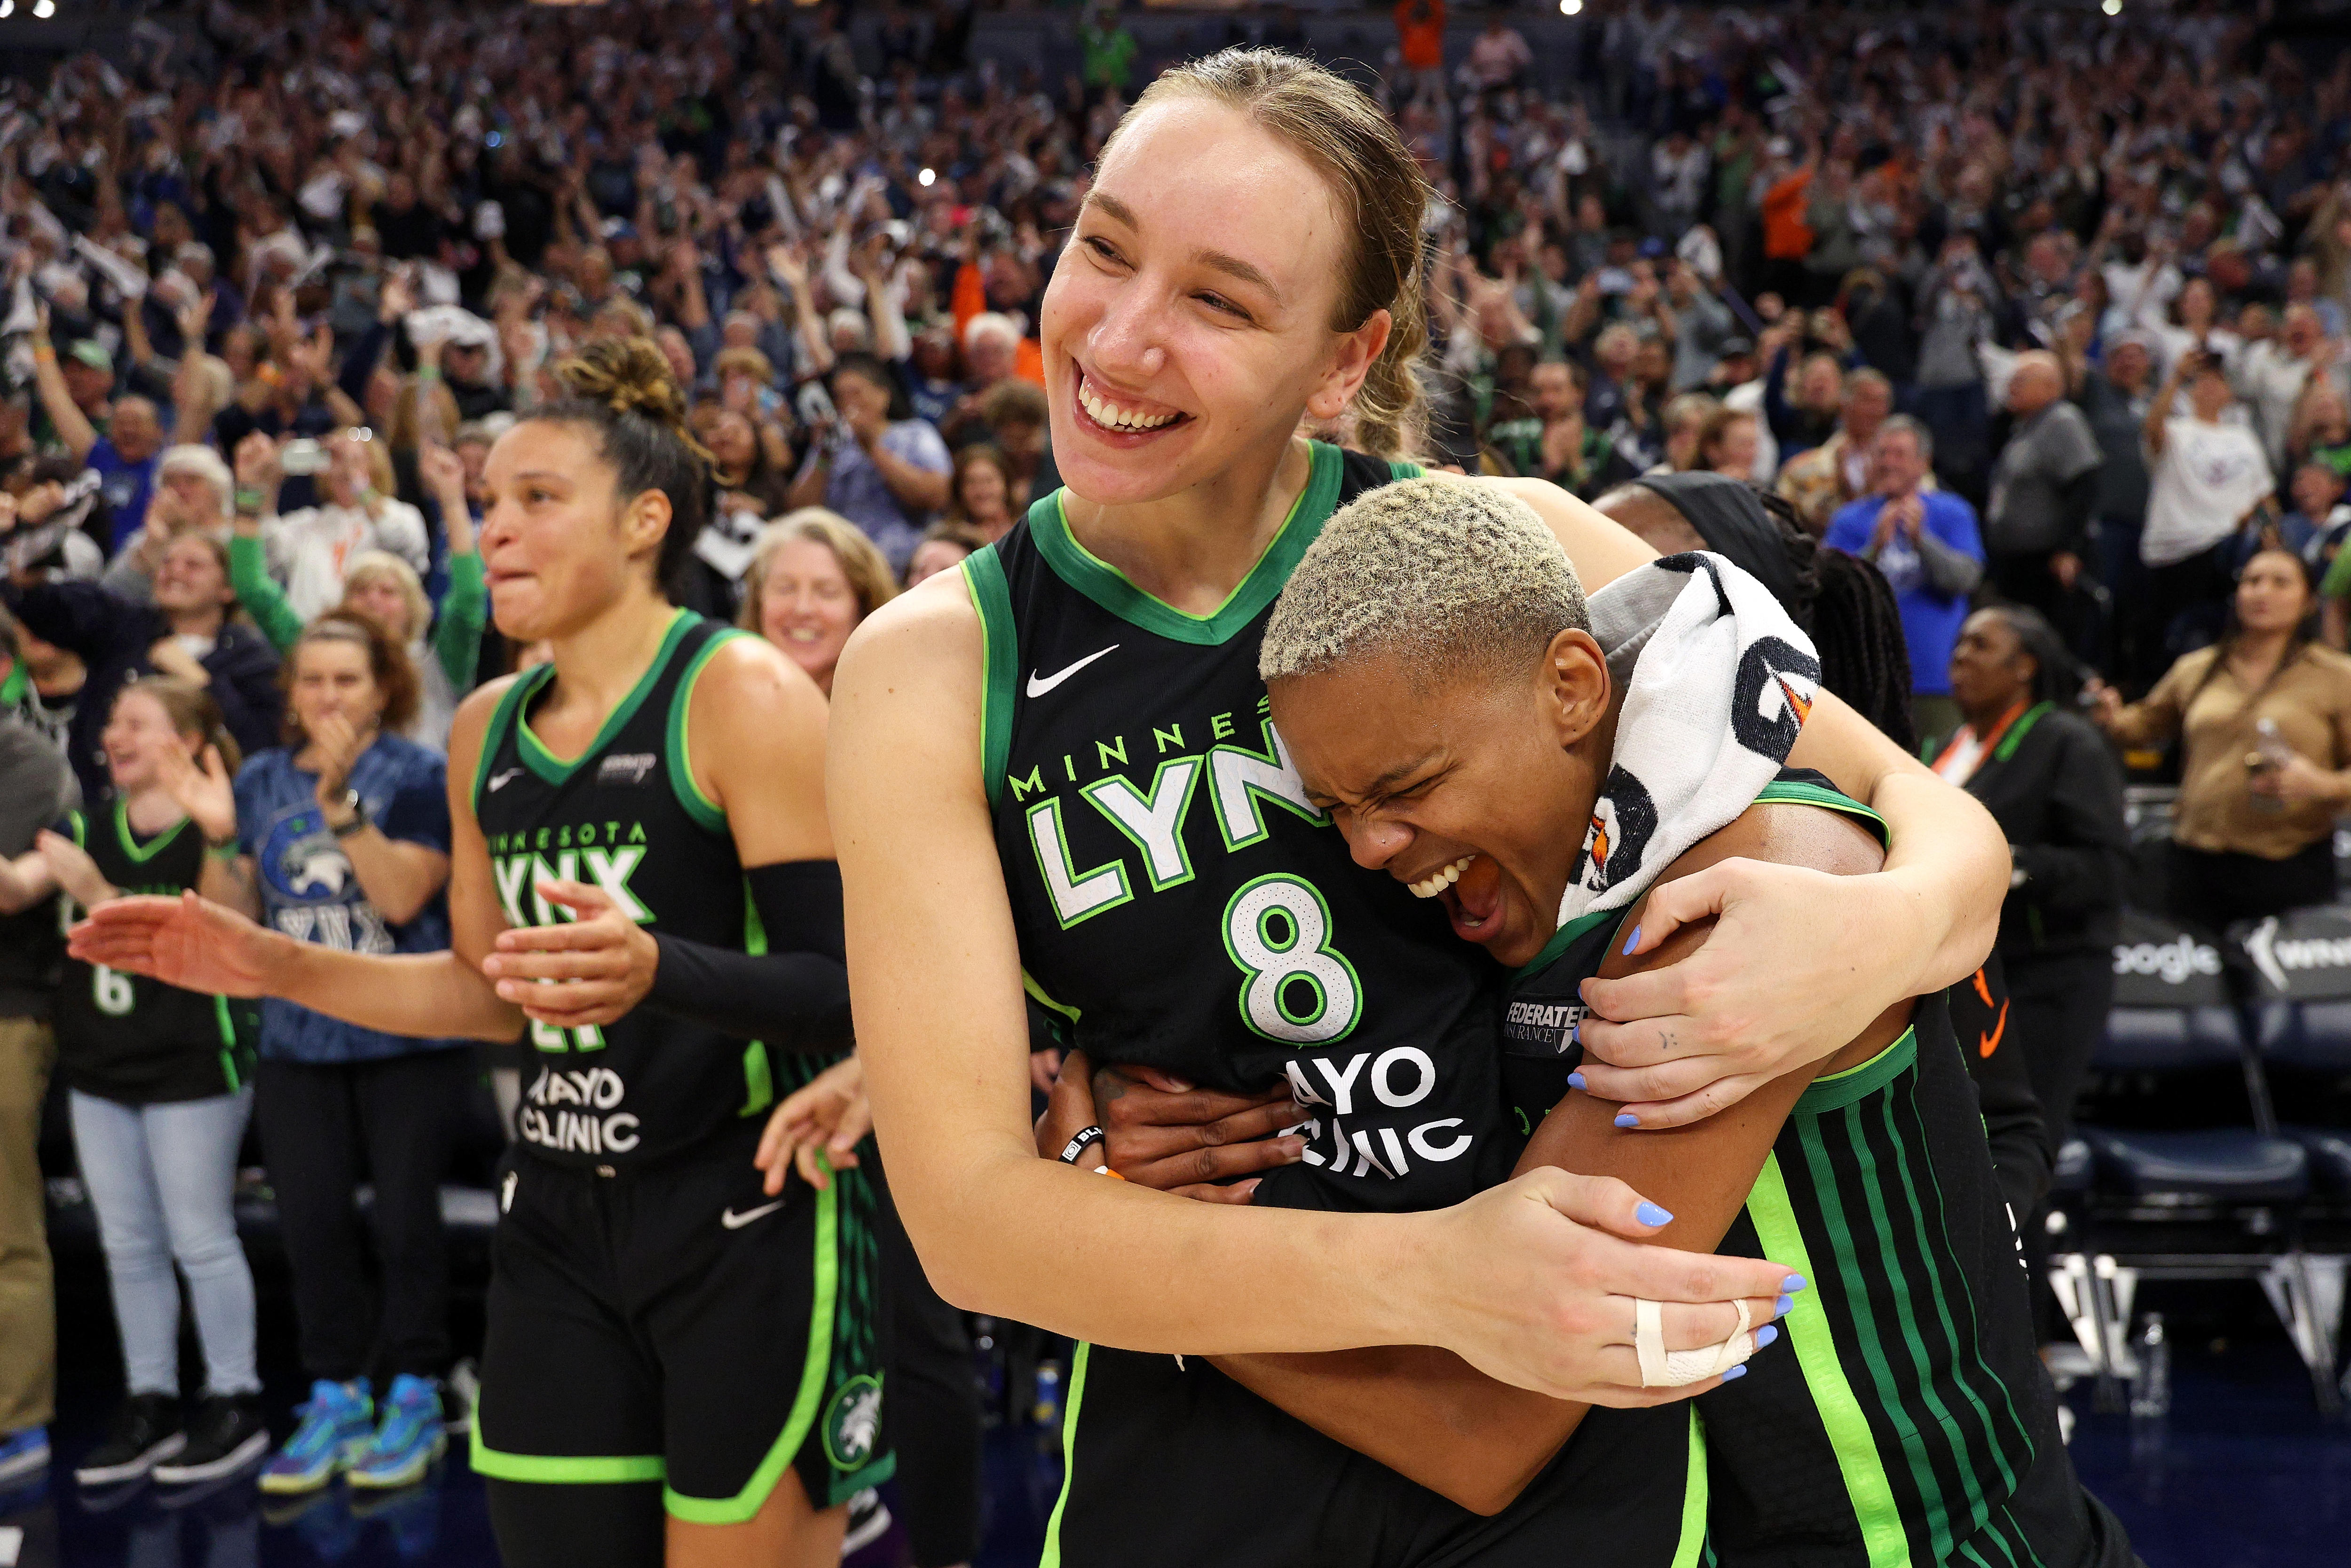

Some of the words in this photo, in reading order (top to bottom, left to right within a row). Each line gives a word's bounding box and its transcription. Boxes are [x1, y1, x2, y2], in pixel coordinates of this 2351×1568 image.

[1008, 694, 1270, 802] MINNES
[488, 821, 647, 852] NNESOTA
[1026, 716, 1334, 930] LYN
[494, 845, 657, 928] YNX
[1222, 873, 1363, 1047] 8
[2112, 933, 2221, 984] oogle
[93, 963, 136, 1016] 6
[1507, 1002, 1590, 1028] FEDERATED
[1504, 1024, 1554, 1043] NSURANCE
[1277, 1046, 1436, 1115] AYO
[520, 1105, 640, 1155] CLINIC
